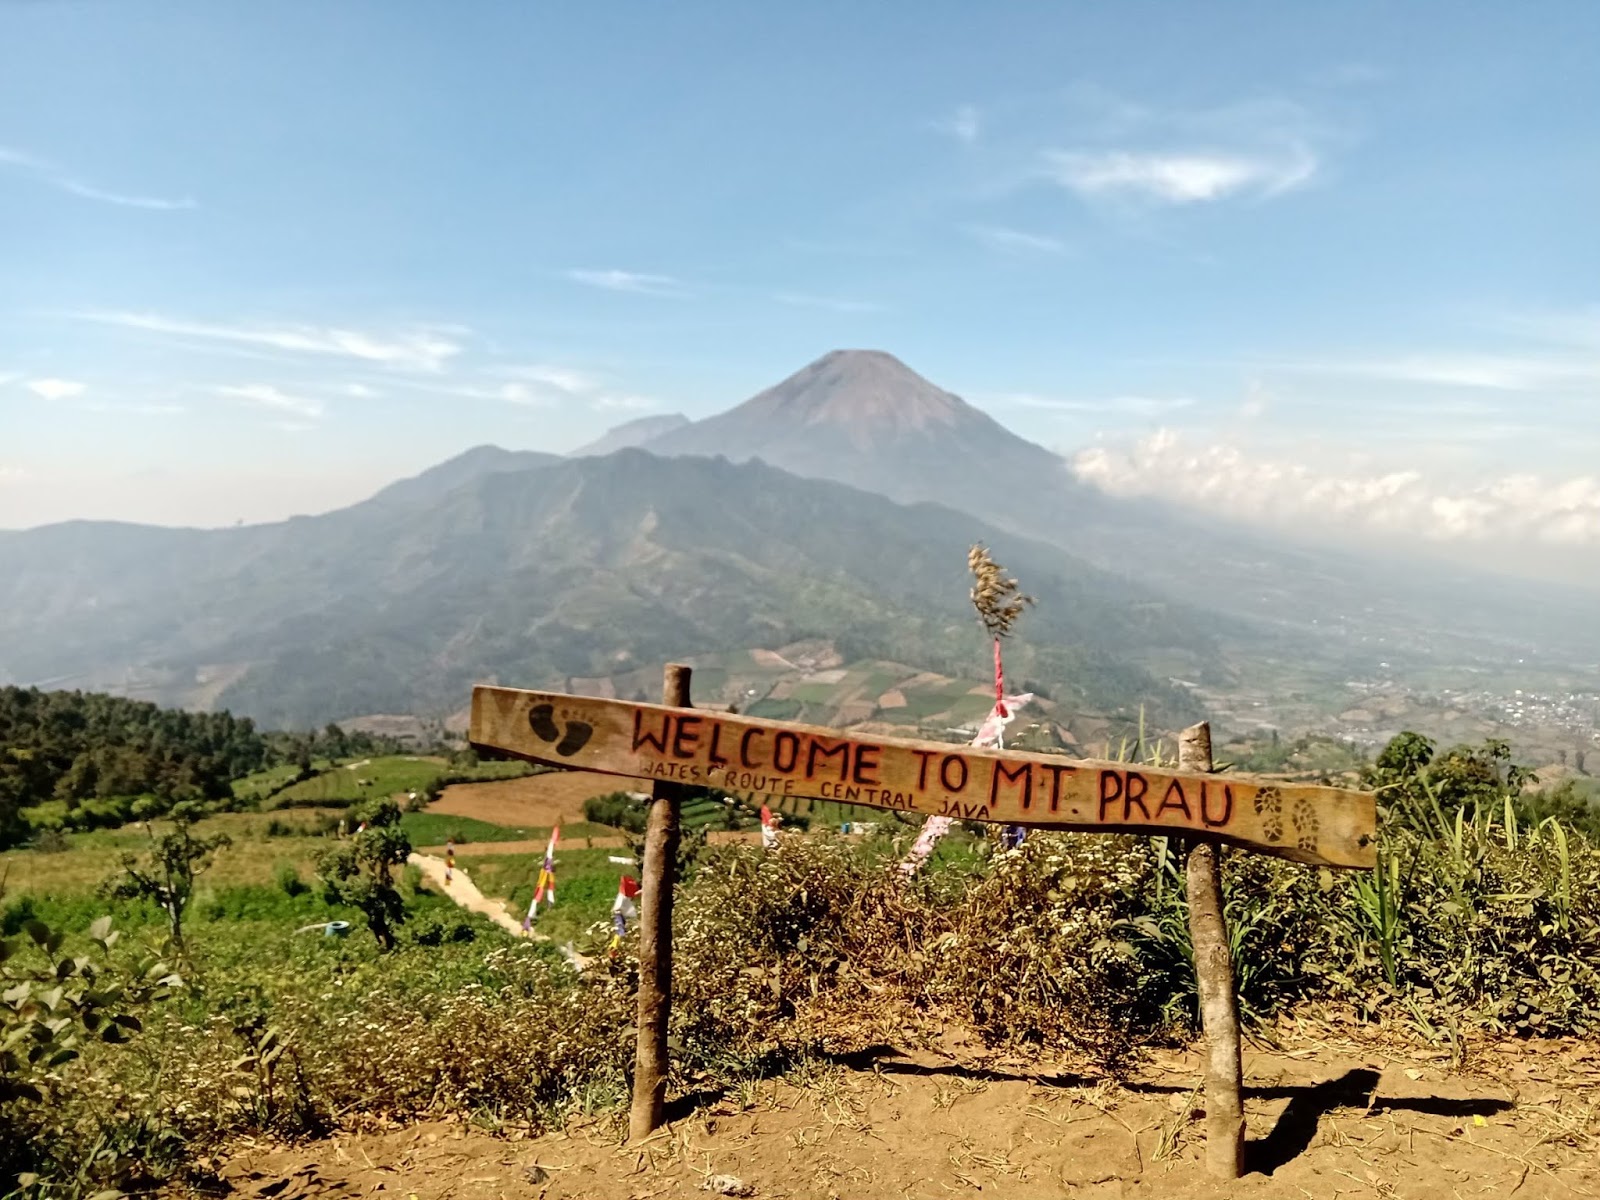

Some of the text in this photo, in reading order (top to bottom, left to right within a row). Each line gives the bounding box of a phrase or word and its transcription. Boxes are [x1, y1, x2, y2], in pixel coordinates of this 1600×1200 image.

[632, 709, 1232, 827] WELCOME TO MT. PRAU
[724, 771, 794, 795] ROUTE
[821, 781, 918, 809] CENTRAL
